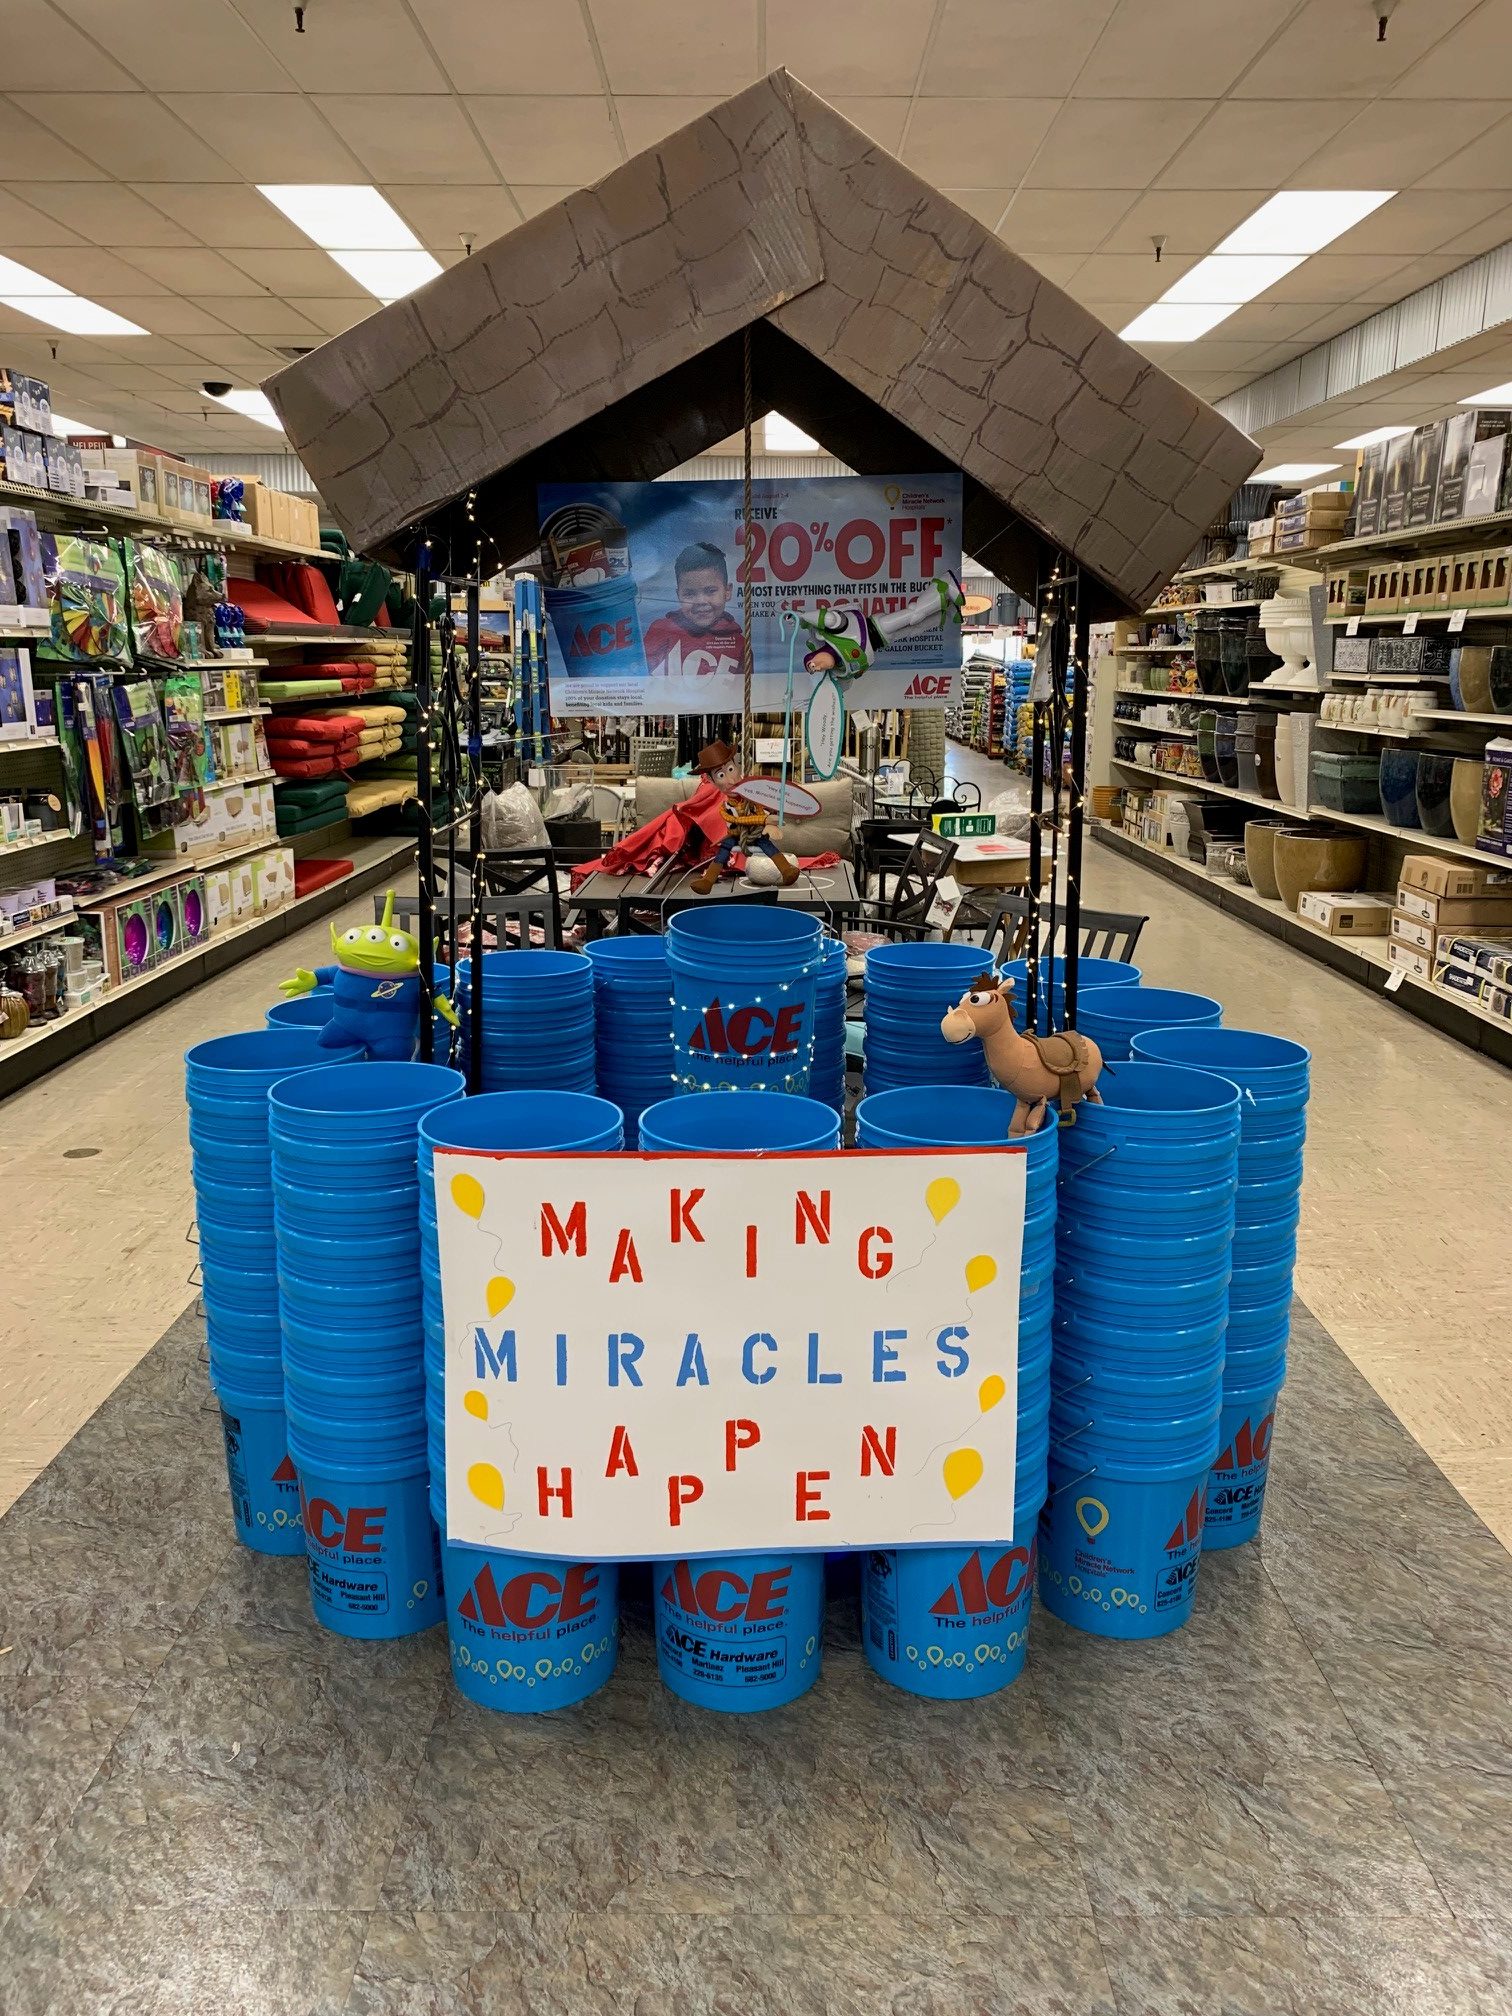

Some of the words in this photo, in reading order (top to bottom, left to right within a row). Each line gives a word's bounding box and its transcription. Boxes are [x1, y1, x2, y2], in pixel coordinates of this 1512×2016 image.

[734, 521, 834, 583] 20%
[736, 585, 773, 598] AMOST
[775, 583, 832, 596] EVERYTHING
[833, 582, 857, 596] THAT
[858, 582, 877, 595] FITS
[878, 582, 889, 594] IN
[890, 582, 907, 593] THE
[910, 581, 932, 593] BUC
[770, 610, 776, 618] A
[569, 616, 634, 658] ACE
[650, 639, 741, 686] ACE
[904, 674, 952, 695] ACE
[688, 996, 806, 1056] ACE
[715, 1054, 763, 1067] helpful
[540, 1188, 894, 1283] MAKING
[474, 1326, 971, 1387] MIRACLES
[536, 1419, 897, 1527] HAPPEN
[1215, 1472, 1237, 1480] The
[1214, 1484, 1254, 1505] ACE
[343, 1555, 386, 1565] place.
[1168, 1548, 1187, 1561] The
[322, 1571, 379, 1592] Hardware
[1102, 1564, 1136, 1575] Network
[457, 1561, 600, 1630] ACE
[661, 1560, 793, 1623] ACE
[664, 1602, 683, 1620] The
[686, 1614, 737, 1634] helpful
[934, 1616, 966, 1629] The
[972, 1604, 1020, 1627] helpful
[460, 1617, 486, 1637] The
[491, 1629, 551, 1643] helpful
[665, 1624, 708, 1658] ACE
[709, 1649, 779, 1663] Hardware
[691, 1657, 725, 1672] Martinez
[736, 1663, 771, 1673] Pleasant
[772, 1658, 785, 1670] Hill
